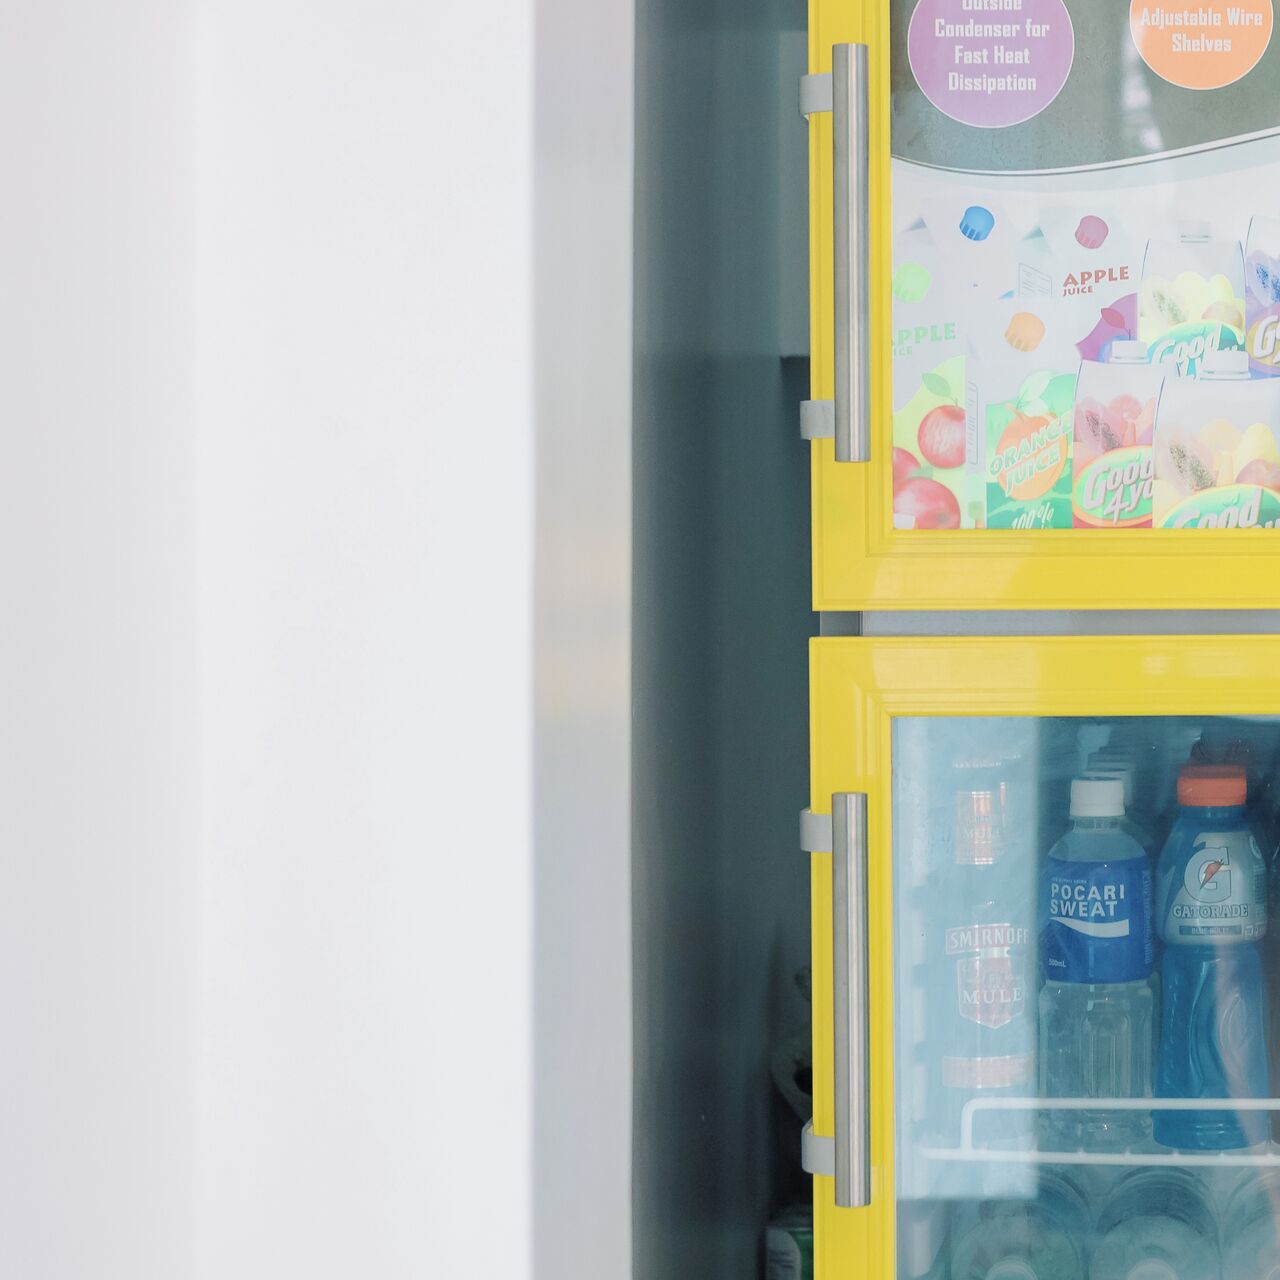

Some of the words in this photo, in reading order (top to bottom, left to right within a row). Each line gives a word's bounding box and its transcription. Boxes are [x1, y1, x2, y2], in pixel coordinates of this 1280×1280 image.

[934, 18, 1020, 37] Condenser
[1025, 18, 1050, 37] for
[1141, 7, 1222, 29] Adjustable
[1226, 7, 1264, 26] Wire
[1171, 33, 1233, 52] Shelves
[954, 45, 989, 64] Fast
[993, 45, 1031, 64] Heat
[948, 72, 1037, 94] Dissipation
[1062, 266, 1130, 287] APPLE
[1062, 285, 1094, 297] JUICE
[894, 322, 957, 346] PPLE
[990, 410, 1074, 476] ORANGE
[1082, 455, 1153, 511] Good
[1103, 478, 1153, 525] 4yo
[1184, 847, 1232, 904] G
[1051, 883, 1125, 901] POCARI
[1049, 899, 1118, 917] SWEAT
[1172, 903, 1249, 919] GATORADE
[950, 927, 1030, 950] SMIRNOFF
[962, 987, 1024, 1005] MULE
